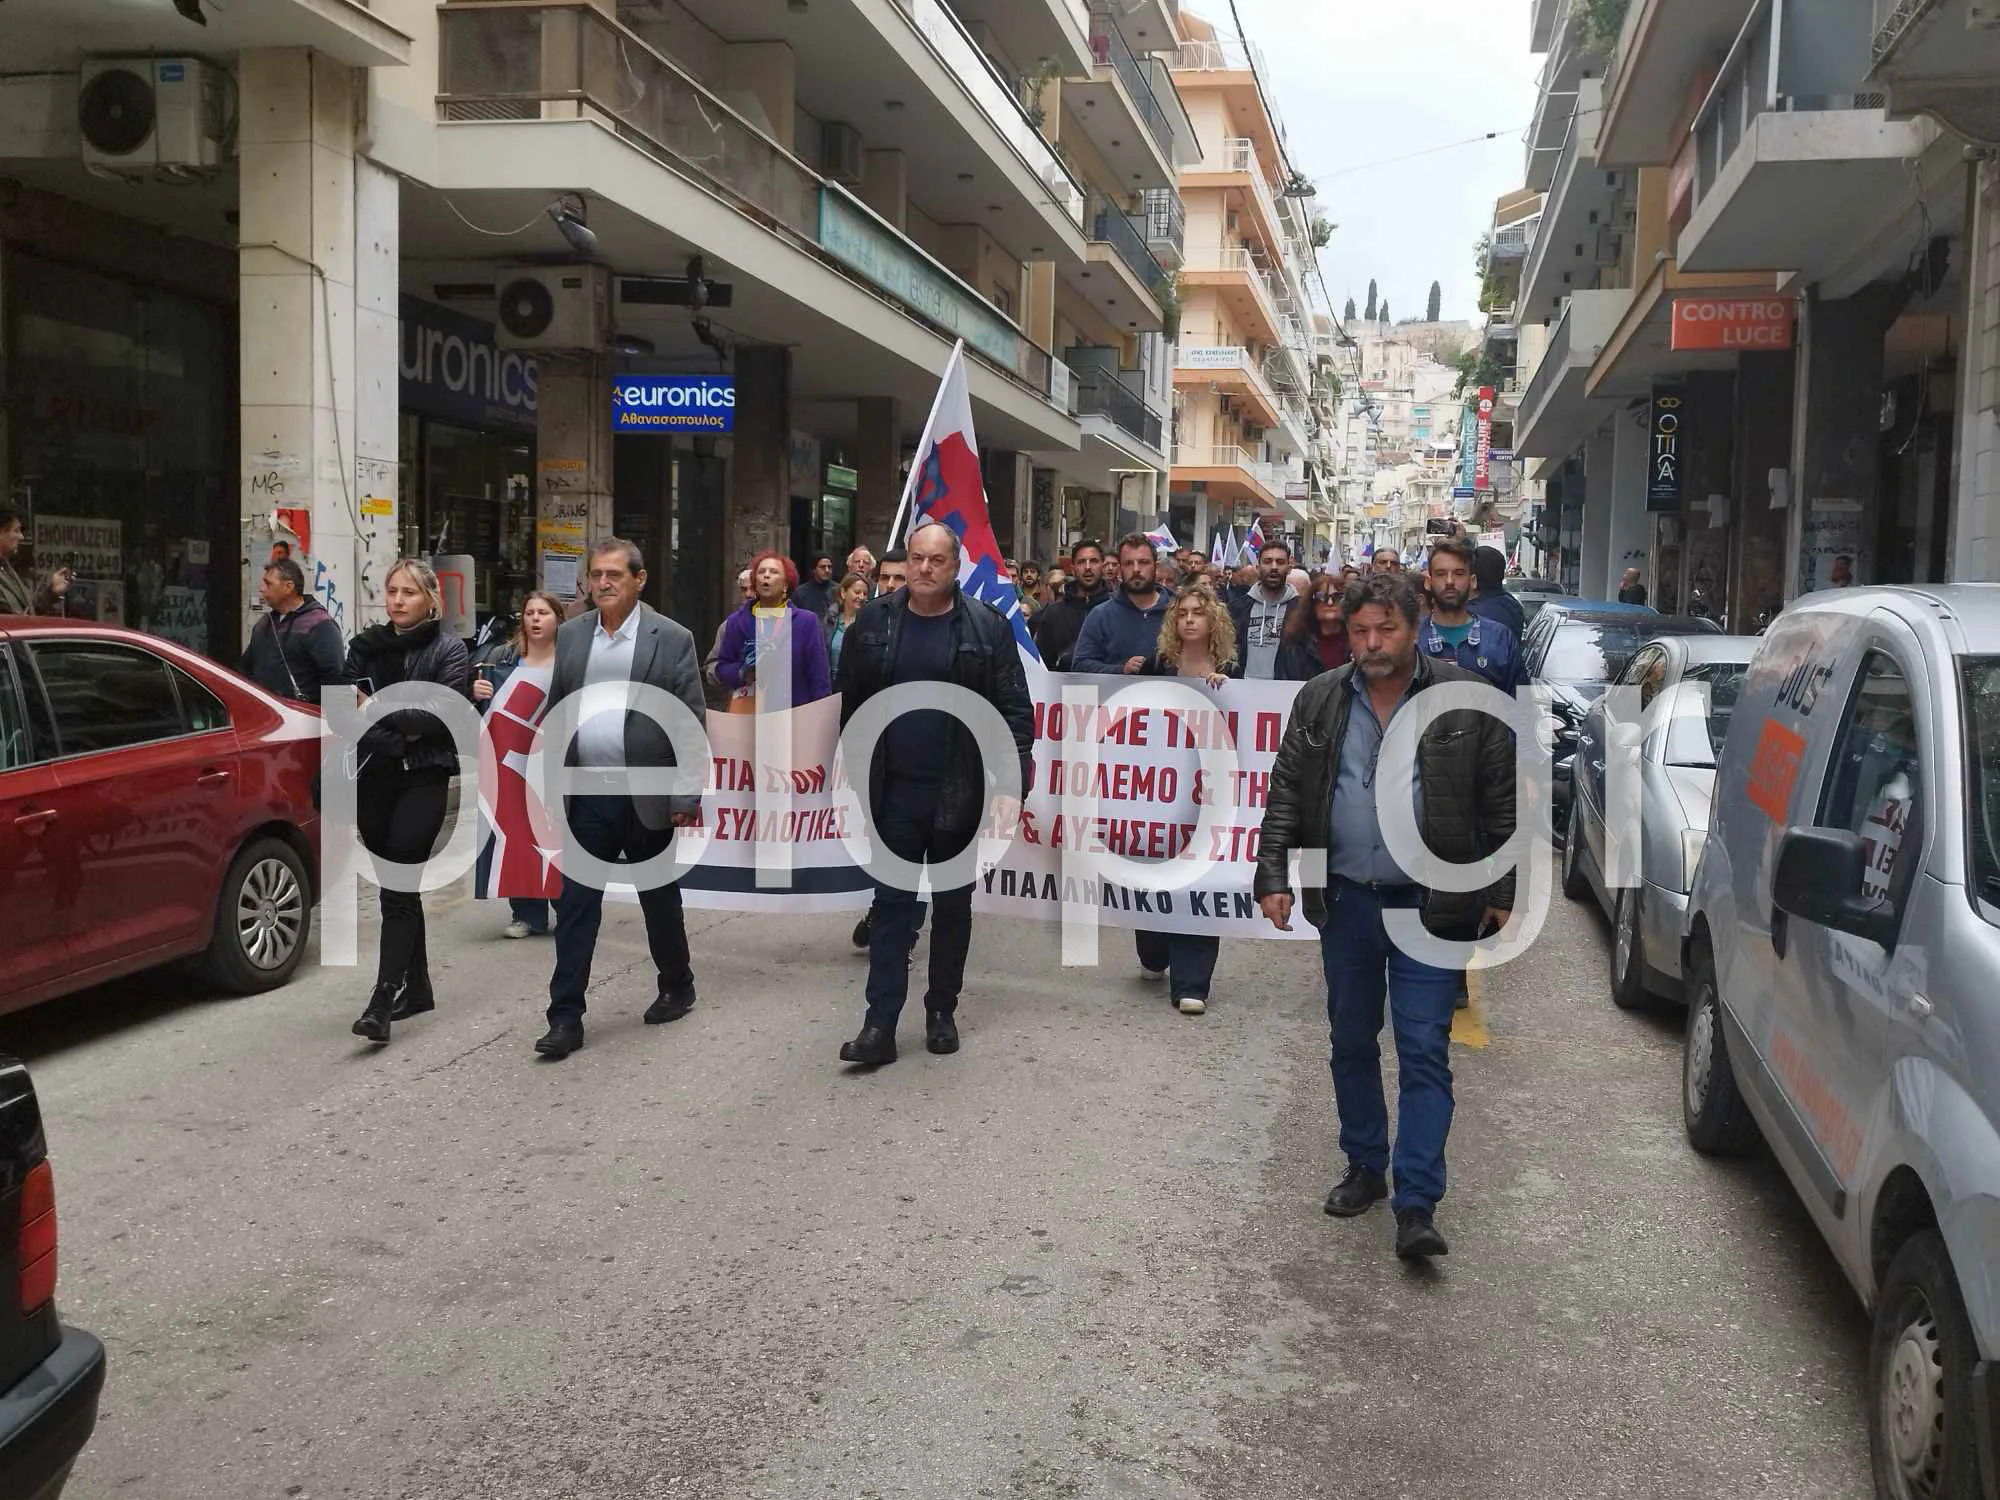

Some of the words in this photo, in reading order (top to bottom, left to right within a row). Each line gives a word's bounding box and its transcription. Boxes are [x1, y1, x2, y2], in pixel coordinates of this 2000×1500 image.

[1682, 303, 1785, 321] CONTRO
[1723, 326, 1784, 344] LUCE
[624, 381, 736, 407] euronics
[1465, 415, 1476, 475] euronics
[1475, 418, 1488, 478] LASERLINE
[1164, 708, 1239, 751] ΤΗΝ
[1049, 759, 1178, 804] ΠΟΛΕΜΟ
[1191, 768, 1216, 806] &
[715, 804, 852, 842] ΣΥΛΛΟΓΙΚΕΣ
[1022, 811, 1041, 845] &
[1051, 815, 1197, 861] ΑΥΞΗΣΕΙΣ
[1190, 890, 1253, 919] ΚΕΝ
